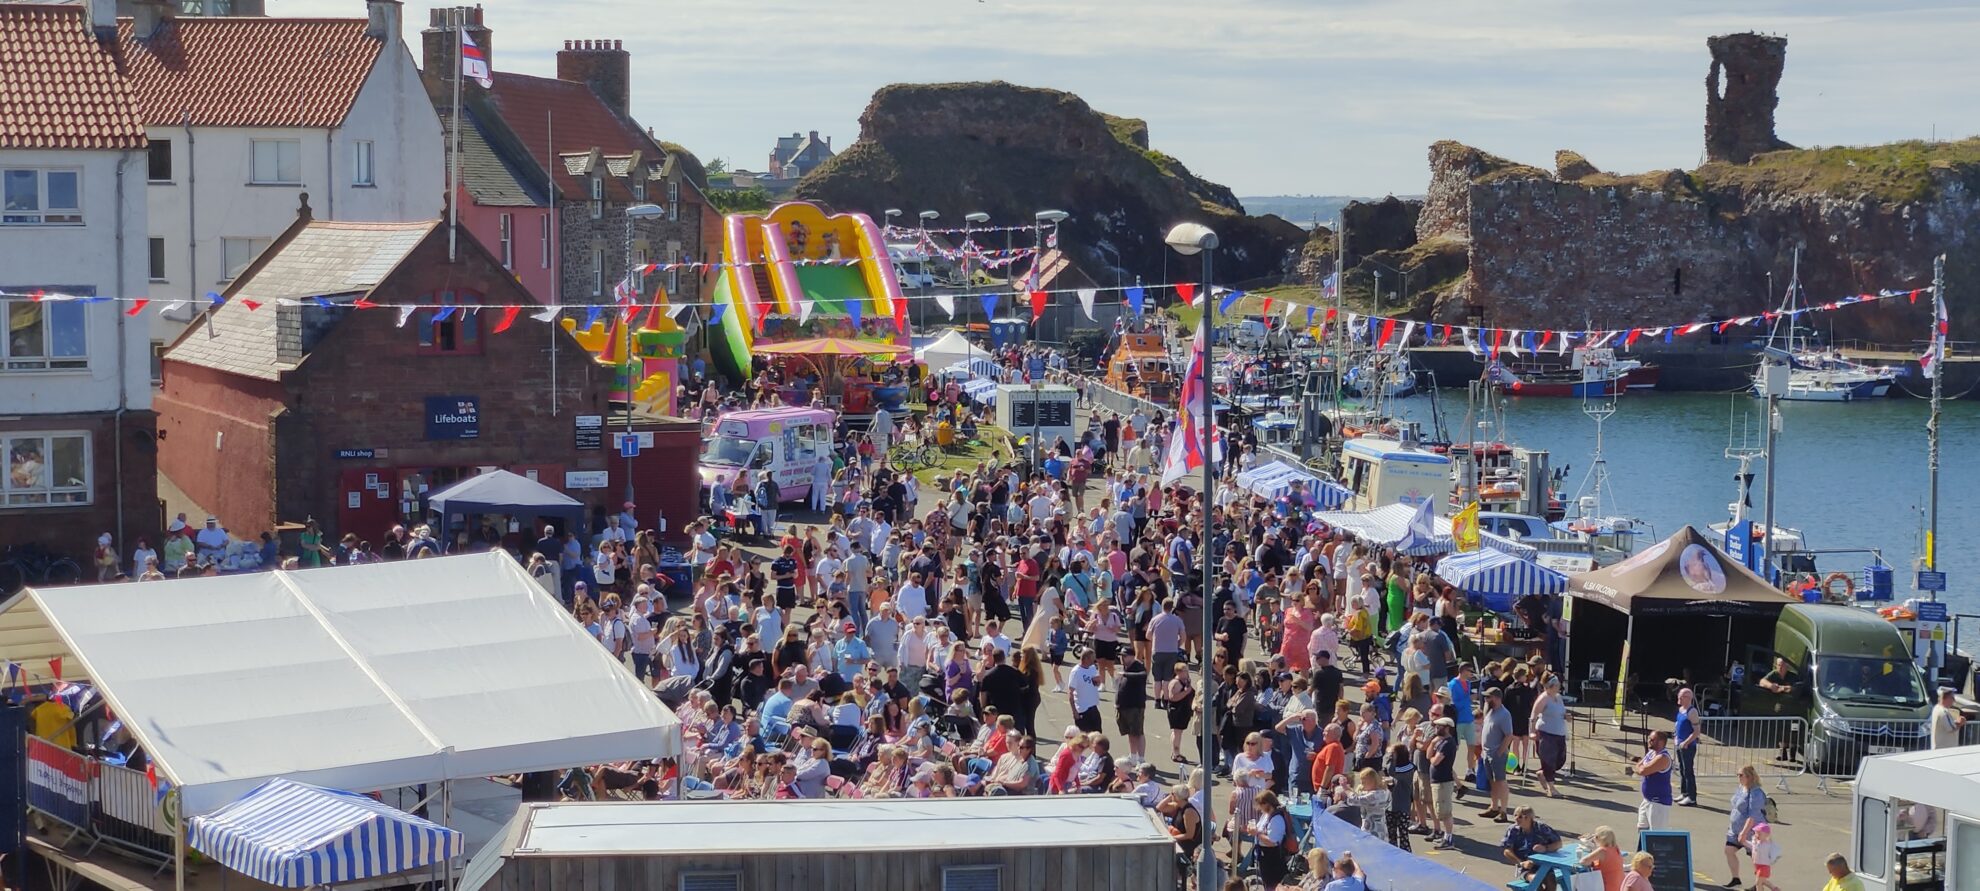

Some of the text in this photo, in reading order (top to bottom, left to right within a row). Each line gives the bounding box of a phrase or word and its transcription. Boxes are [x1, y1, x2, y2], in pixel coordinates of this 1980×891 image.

[435, 414, 477, 423] Lifeboats
[357, 450, 373, 458] shop
[1583, 580, 1597, 591] ALBA
